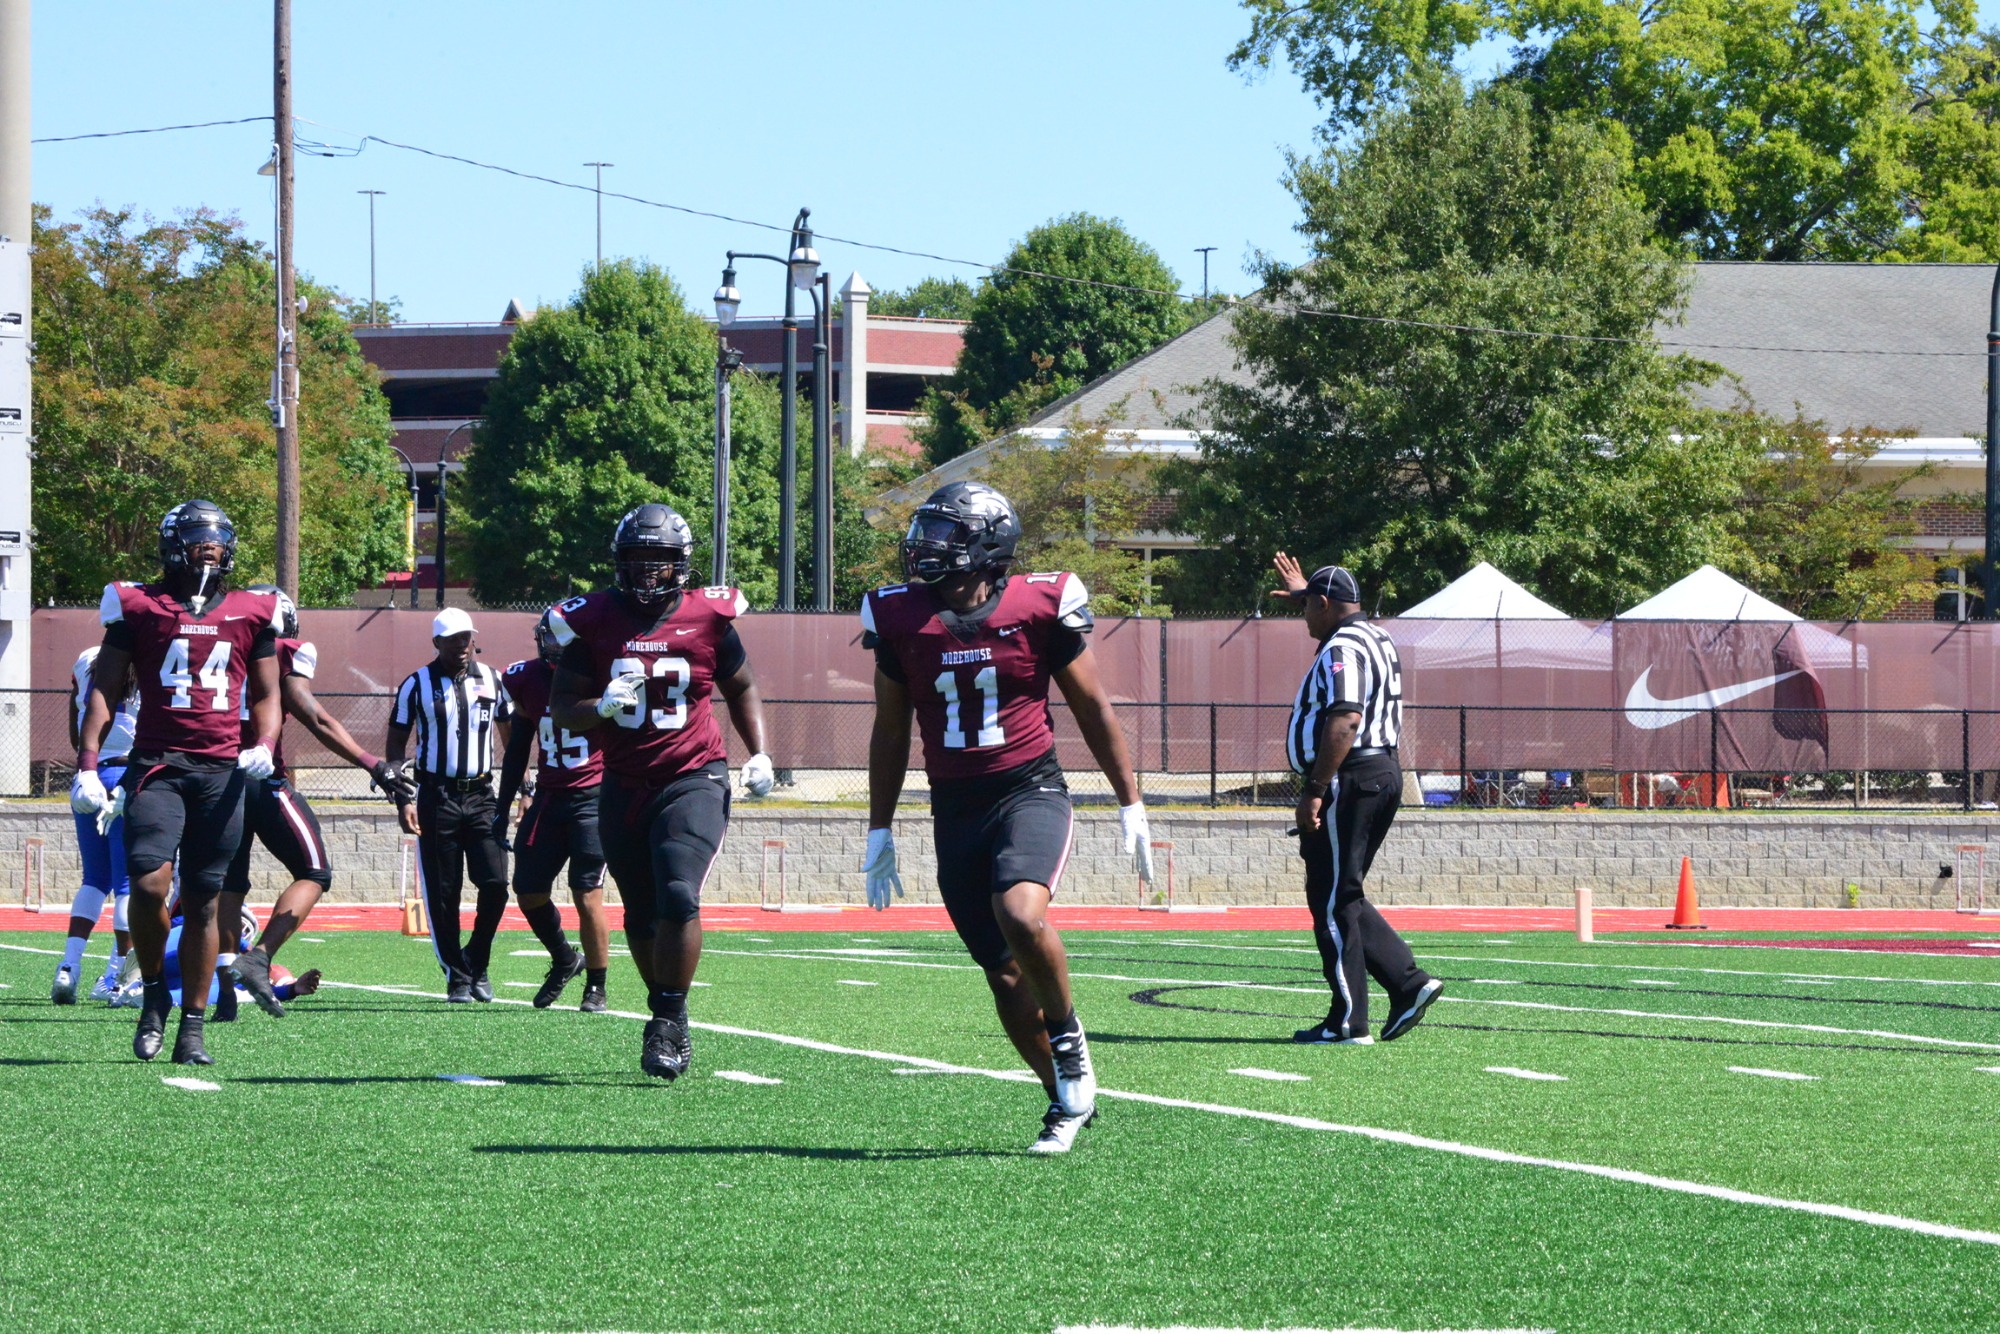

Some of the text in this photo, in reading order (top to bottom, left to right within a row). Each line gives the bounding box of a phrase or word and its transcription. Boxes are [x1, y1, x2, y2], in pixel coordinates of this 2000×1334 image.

[180, 624, 218, 635] MOREHOUSE
[626, 641, 668, 652] MOREHOUSE
[941, 647, 992, 665] MOREHOUSE
[159, 638, 233, 711] 44
[480, 709, 490, 721] R
[934, 666, 1006, 748] 11
[538, 716, 590, 769] 45
[410, 903, 421, 933] 1
